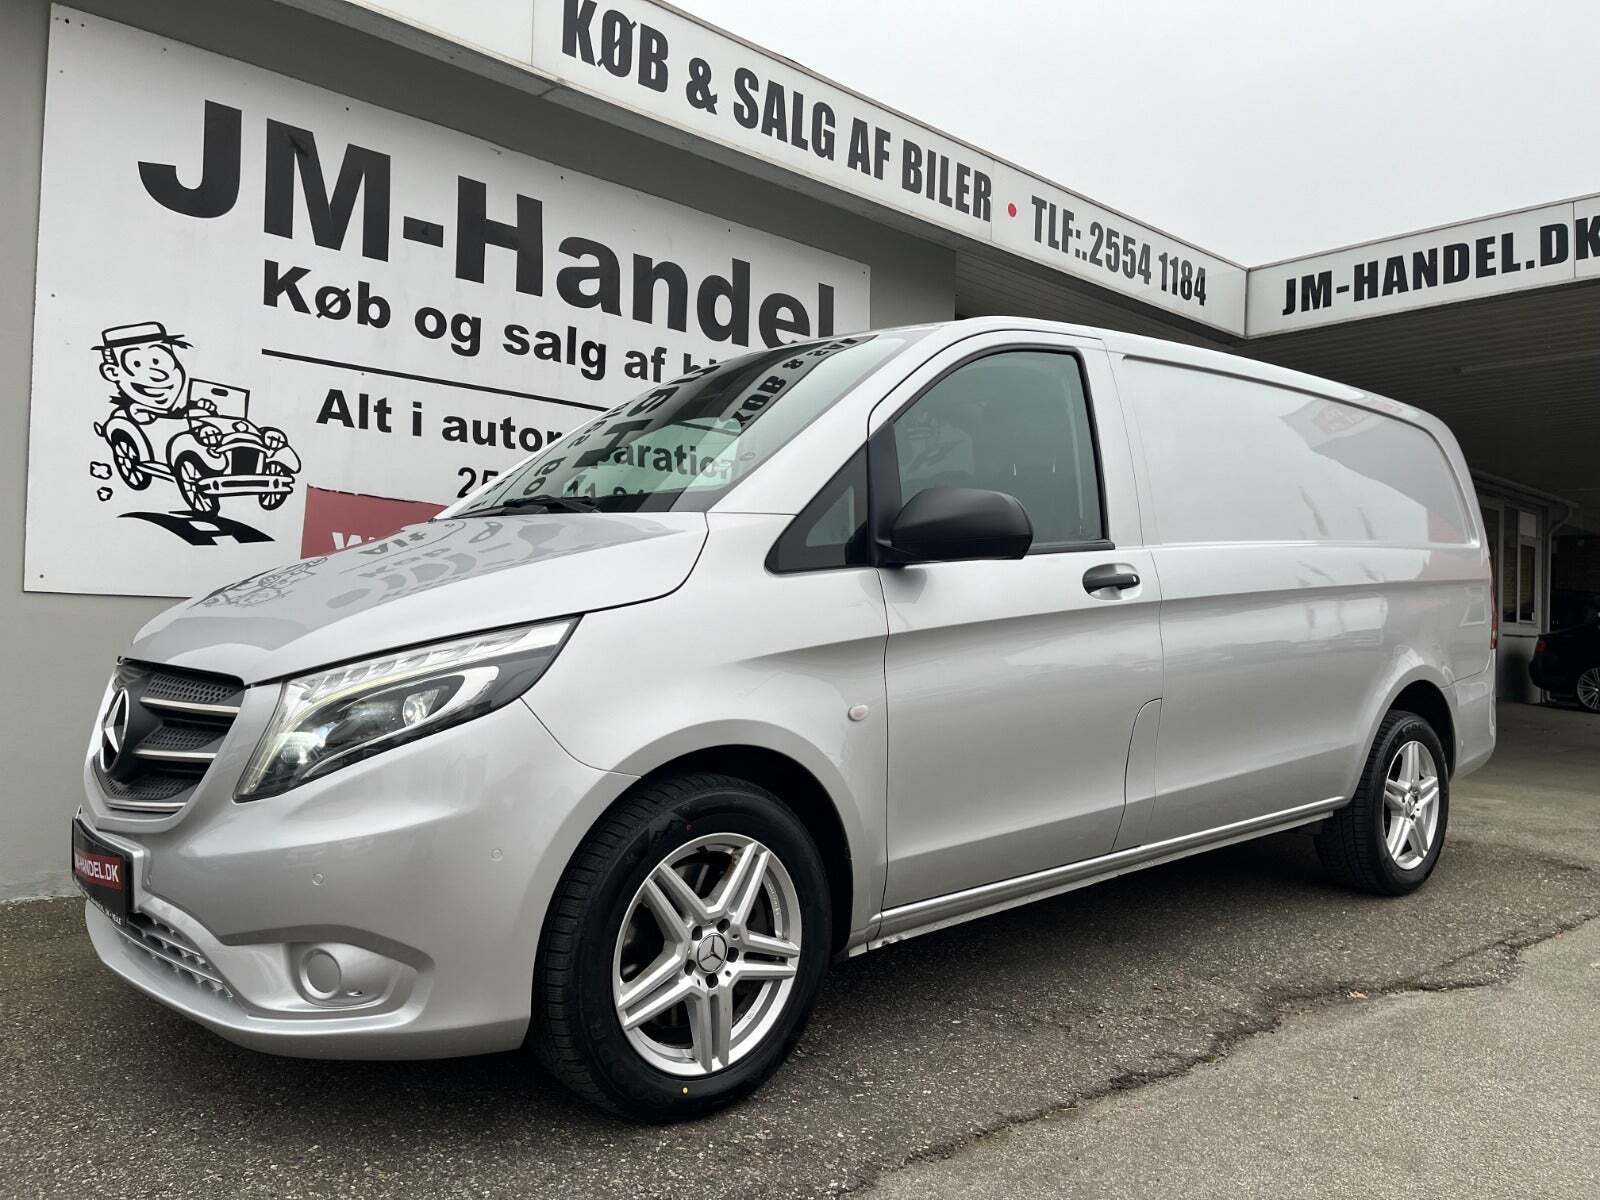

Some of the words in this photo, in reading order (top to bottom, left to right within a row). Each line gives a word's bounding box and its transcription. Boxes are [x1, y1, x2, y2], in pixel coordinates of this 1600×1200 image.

[562, 0, 668, 93] KØB
[685, 57, 718, 115] &
[733, 67, 836, 161] SALG
[847, 117, 891, 181] AF
[902, 139, 992, 222] BILER
[1159, 252, 1206, 306] 1184
[137, 99, 834, 348] JM-Handel
[1282, 214, 1600, 316] JM-HANDEL.DK
[263, 259, 391, 329] Køb
[414, 306, 481, 357] og
[502, 324, 606, 381] salg
[624, 347, 667, 383] af
[316, 389, 392, 433] Alt
[412, 401, 422, 437] i
